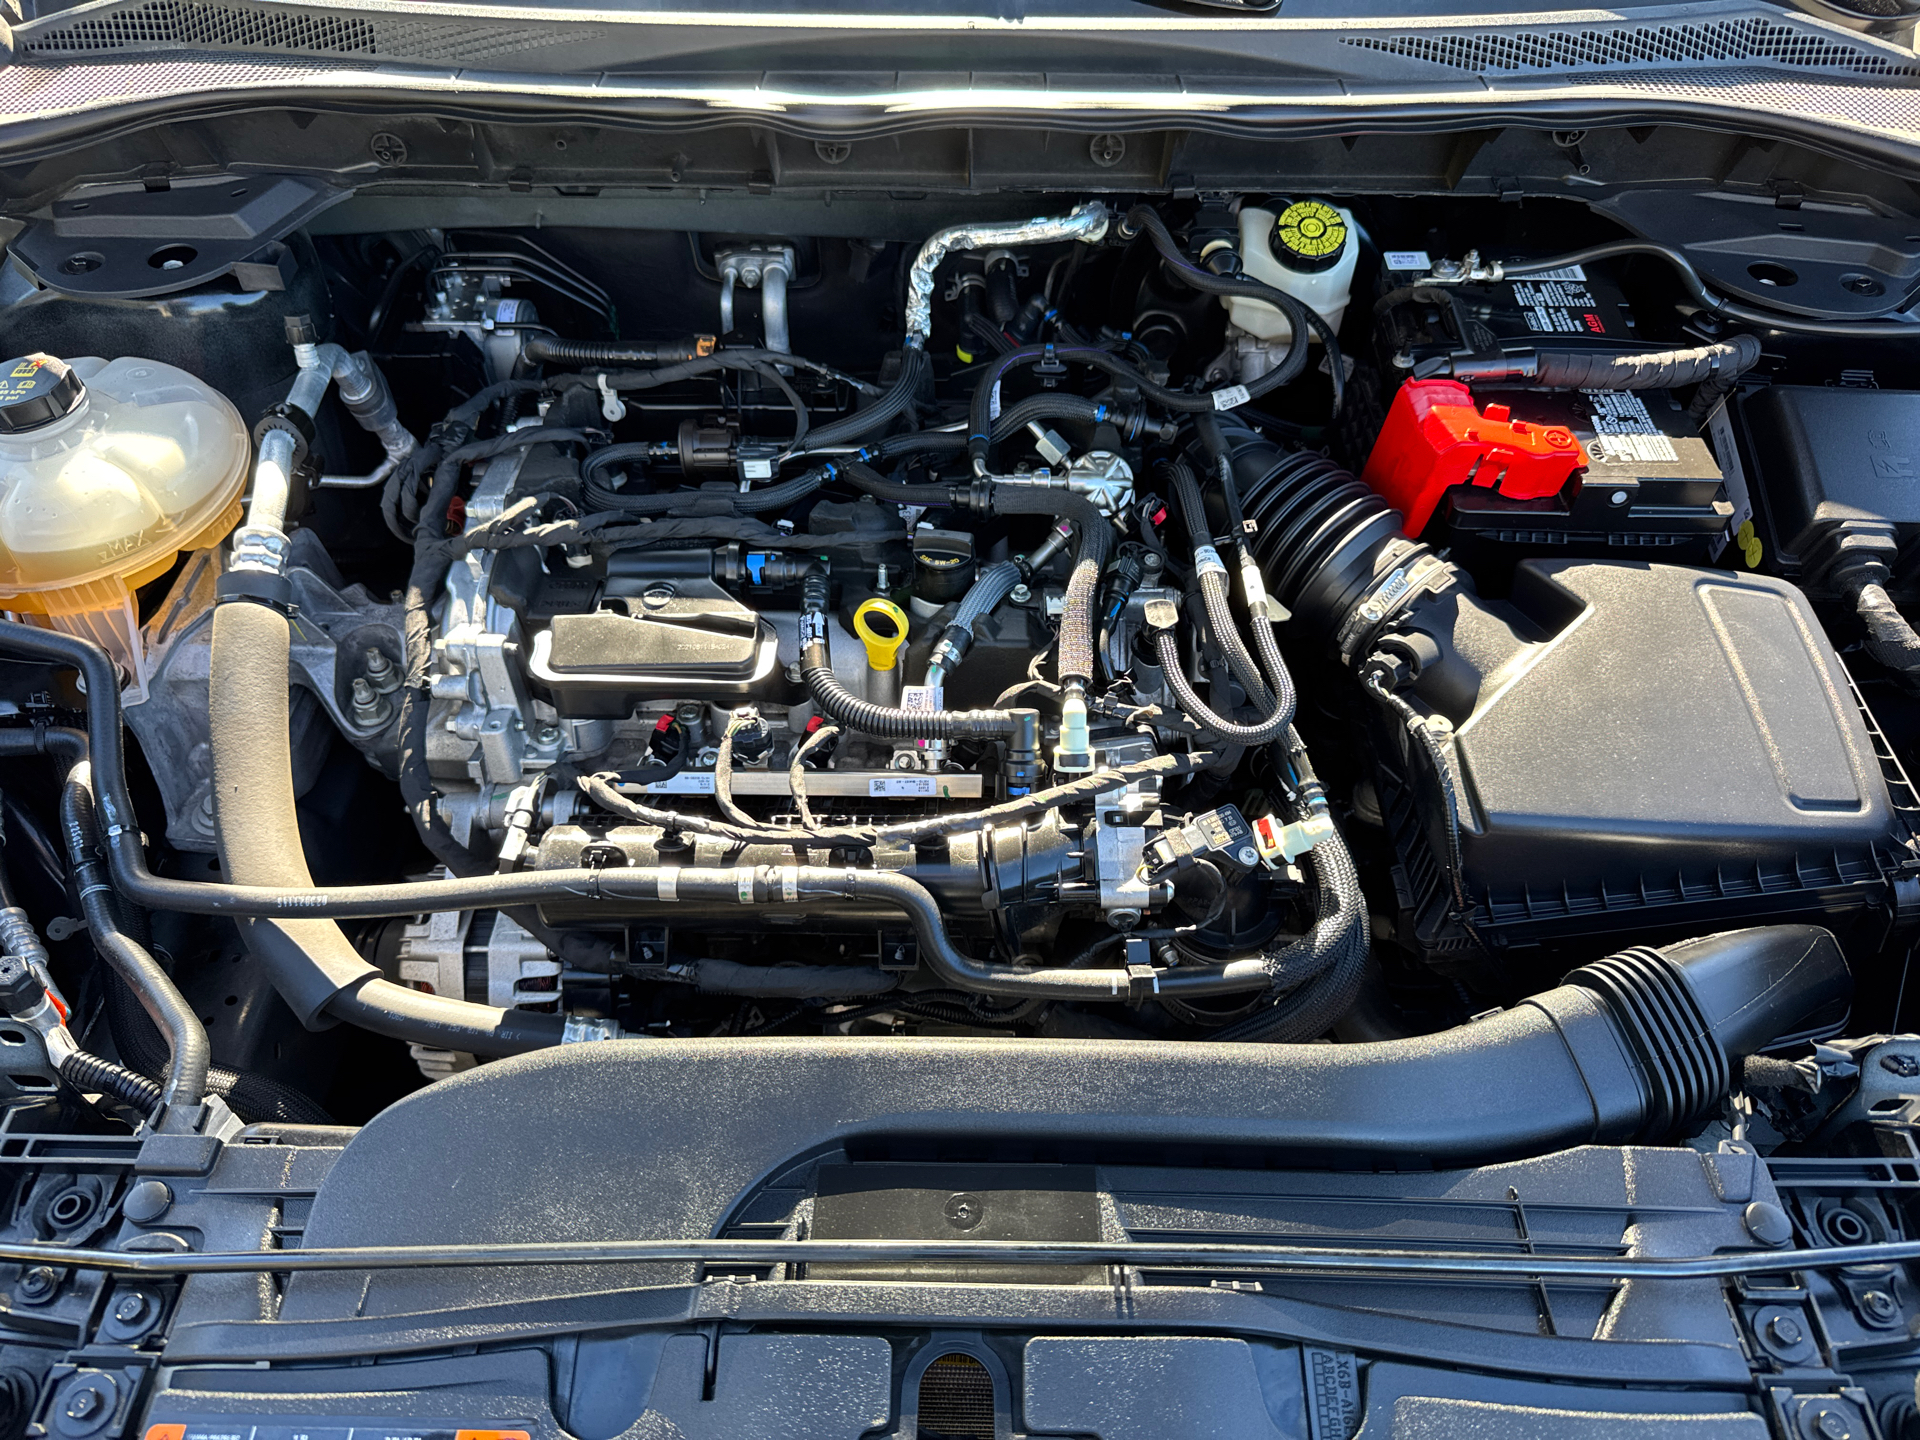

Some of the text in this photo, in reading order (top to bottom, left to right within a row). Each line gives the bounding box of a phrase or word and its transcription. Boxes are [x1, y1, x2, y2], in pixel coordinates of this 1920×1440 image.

[1583, 314, 1601, 333] AGM
[107, 529, 146, 557] MAX
[920, 554, 933, 563] SAE
[1335, 1350, 1357, 1440] LX6B-A16E
